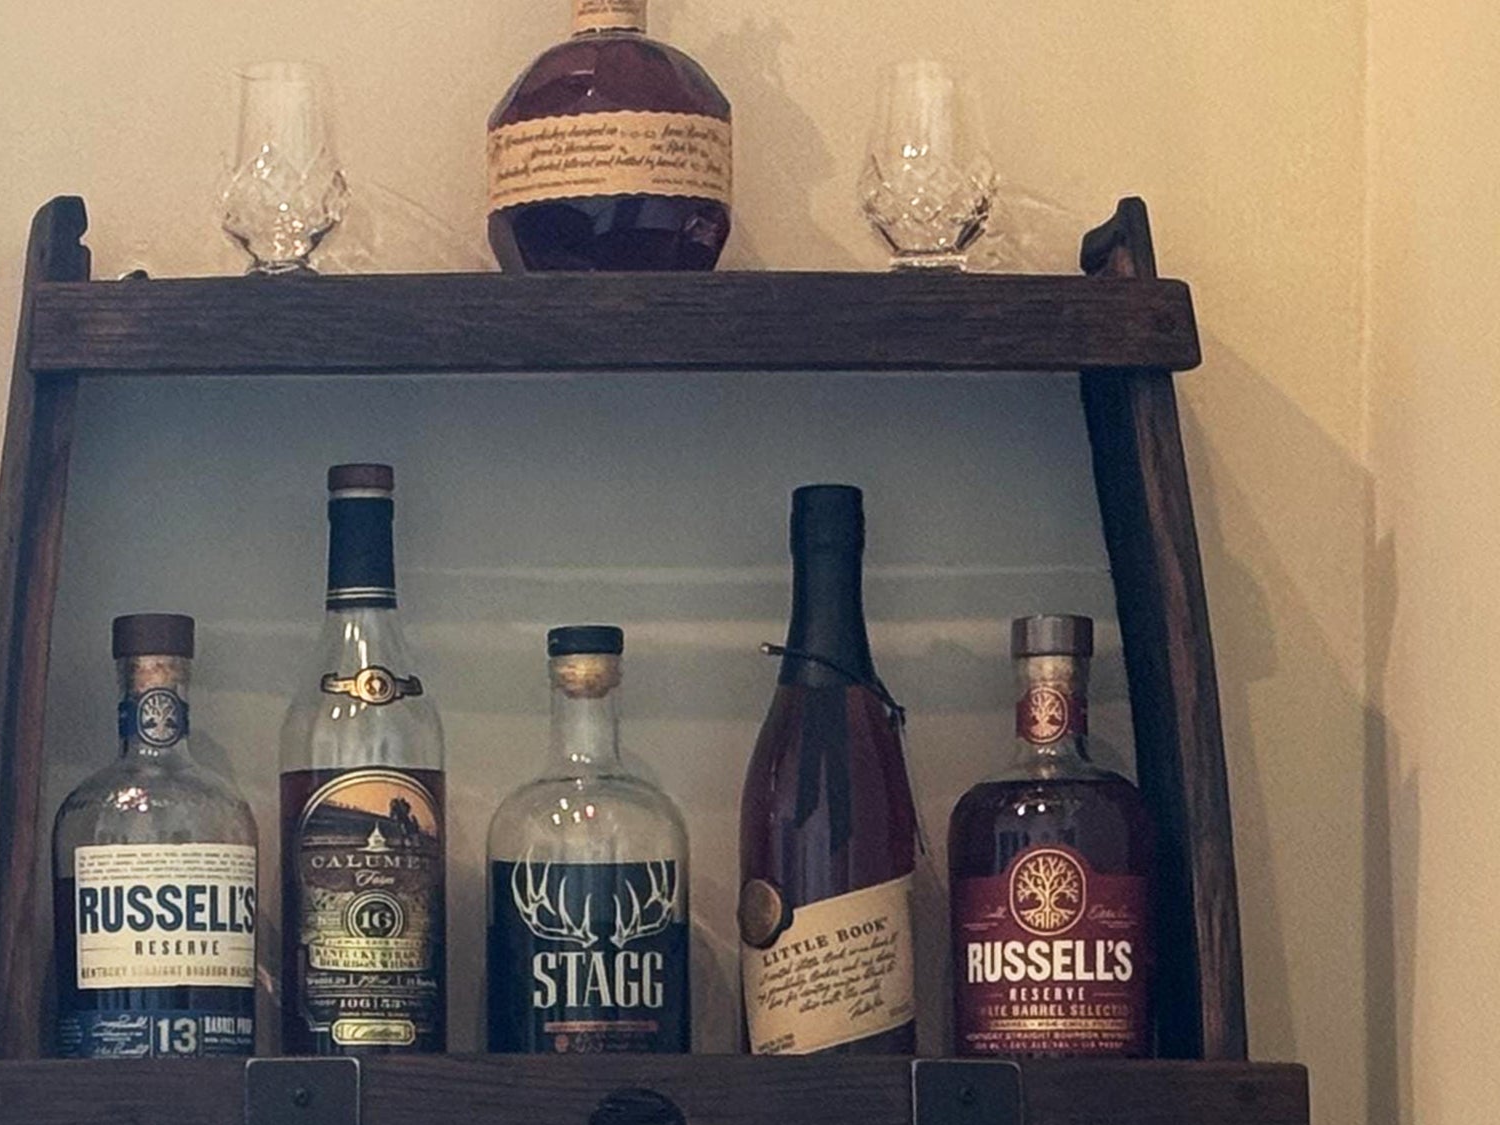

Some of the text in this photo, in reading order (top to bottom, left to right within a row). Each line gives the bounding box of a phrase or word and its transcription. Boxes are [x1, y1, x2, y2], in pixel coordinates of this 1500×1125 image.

[79, 884, 255, 934] RUSSELL'S
[360, 911, 393, 929] 16
[135, 940, 219, 955] RESERVE
[762, 934, 830, 967] LITTLE
[835, 917, 887, 943] BOOK
[533, 951, 663, 1009] STAGG
[967, 940, 1133, 983] RUSSELL'S
[1009, 987, 1084, 1001] RESERVE
[1012, 1004, 1065, 1016] BARREL
[157, 1017, 198, 1054] 13
